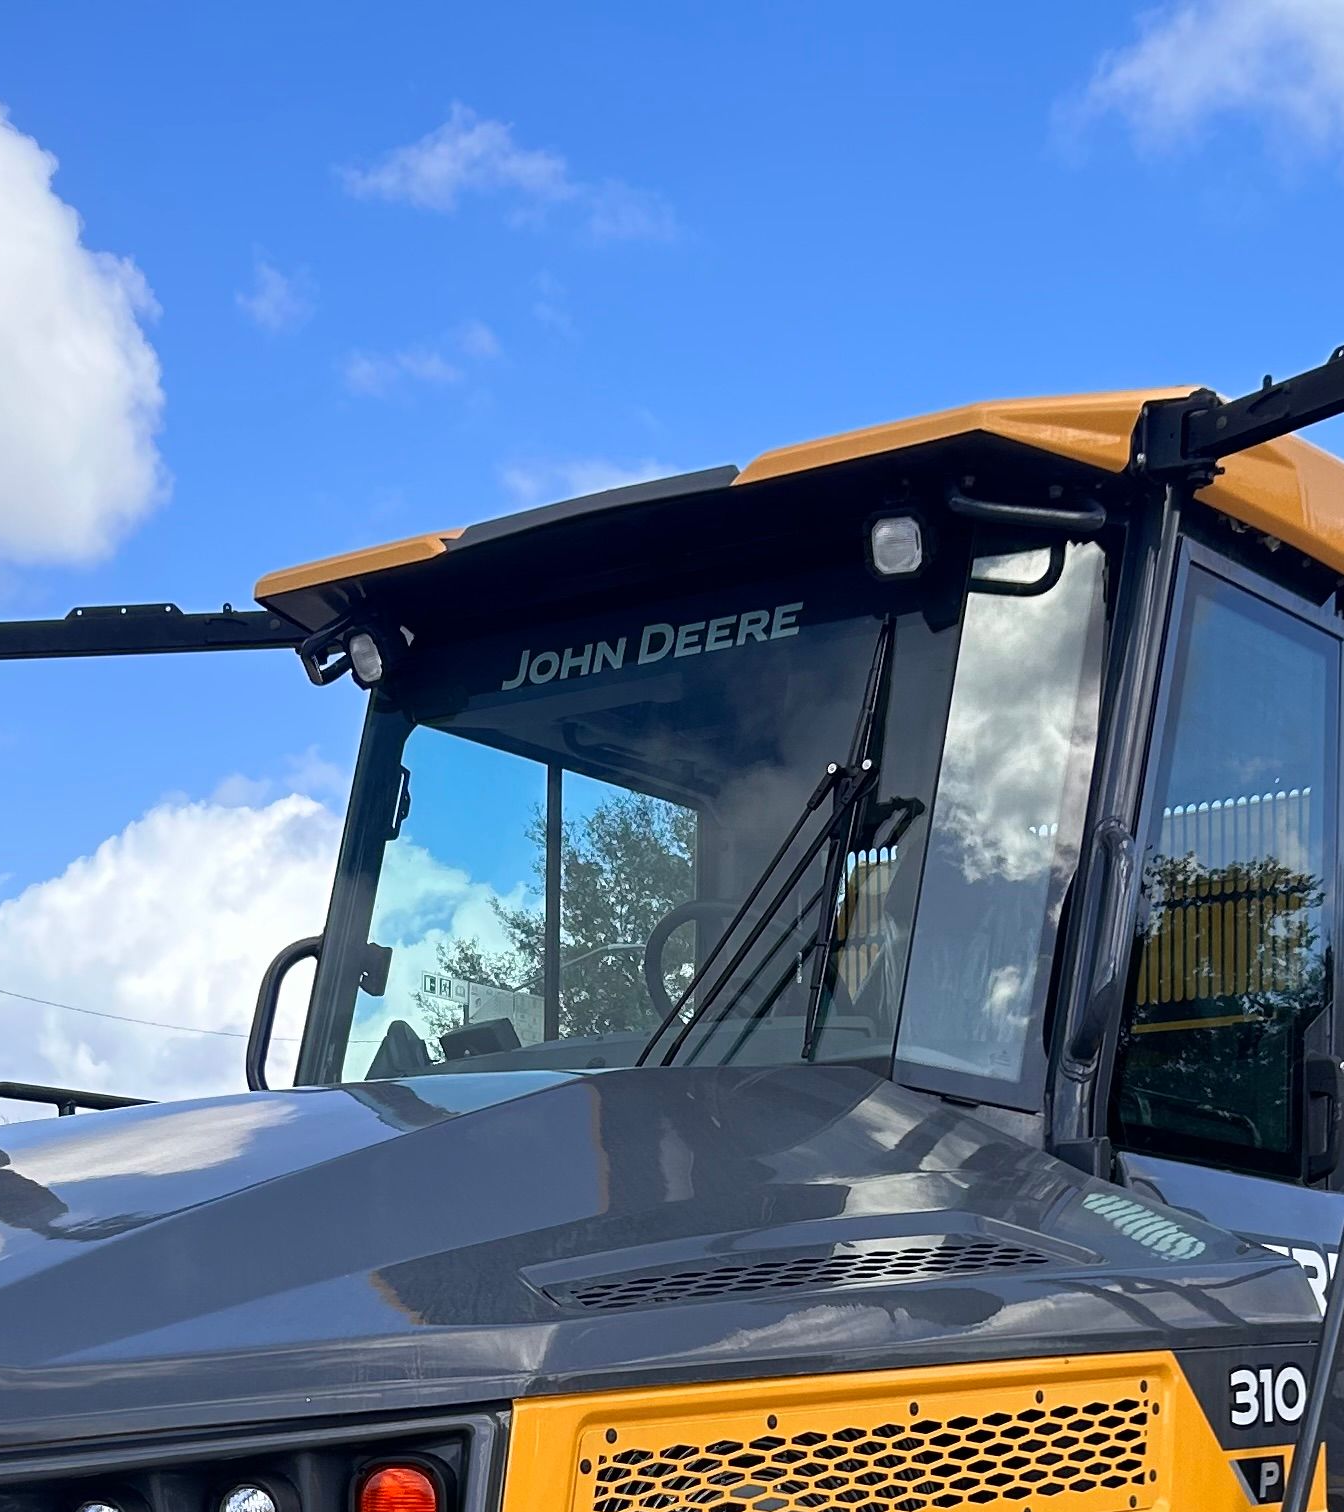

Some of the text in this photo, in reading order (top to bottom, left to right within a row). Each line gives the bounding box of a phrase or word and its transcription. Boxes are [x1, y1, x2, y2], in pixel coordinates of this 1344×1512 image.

[501, 601, 804, 691] JOHN DEERE
[1230, 1366, 1307, 1426] 310
[1259, 1461, 1280, 1499] P
